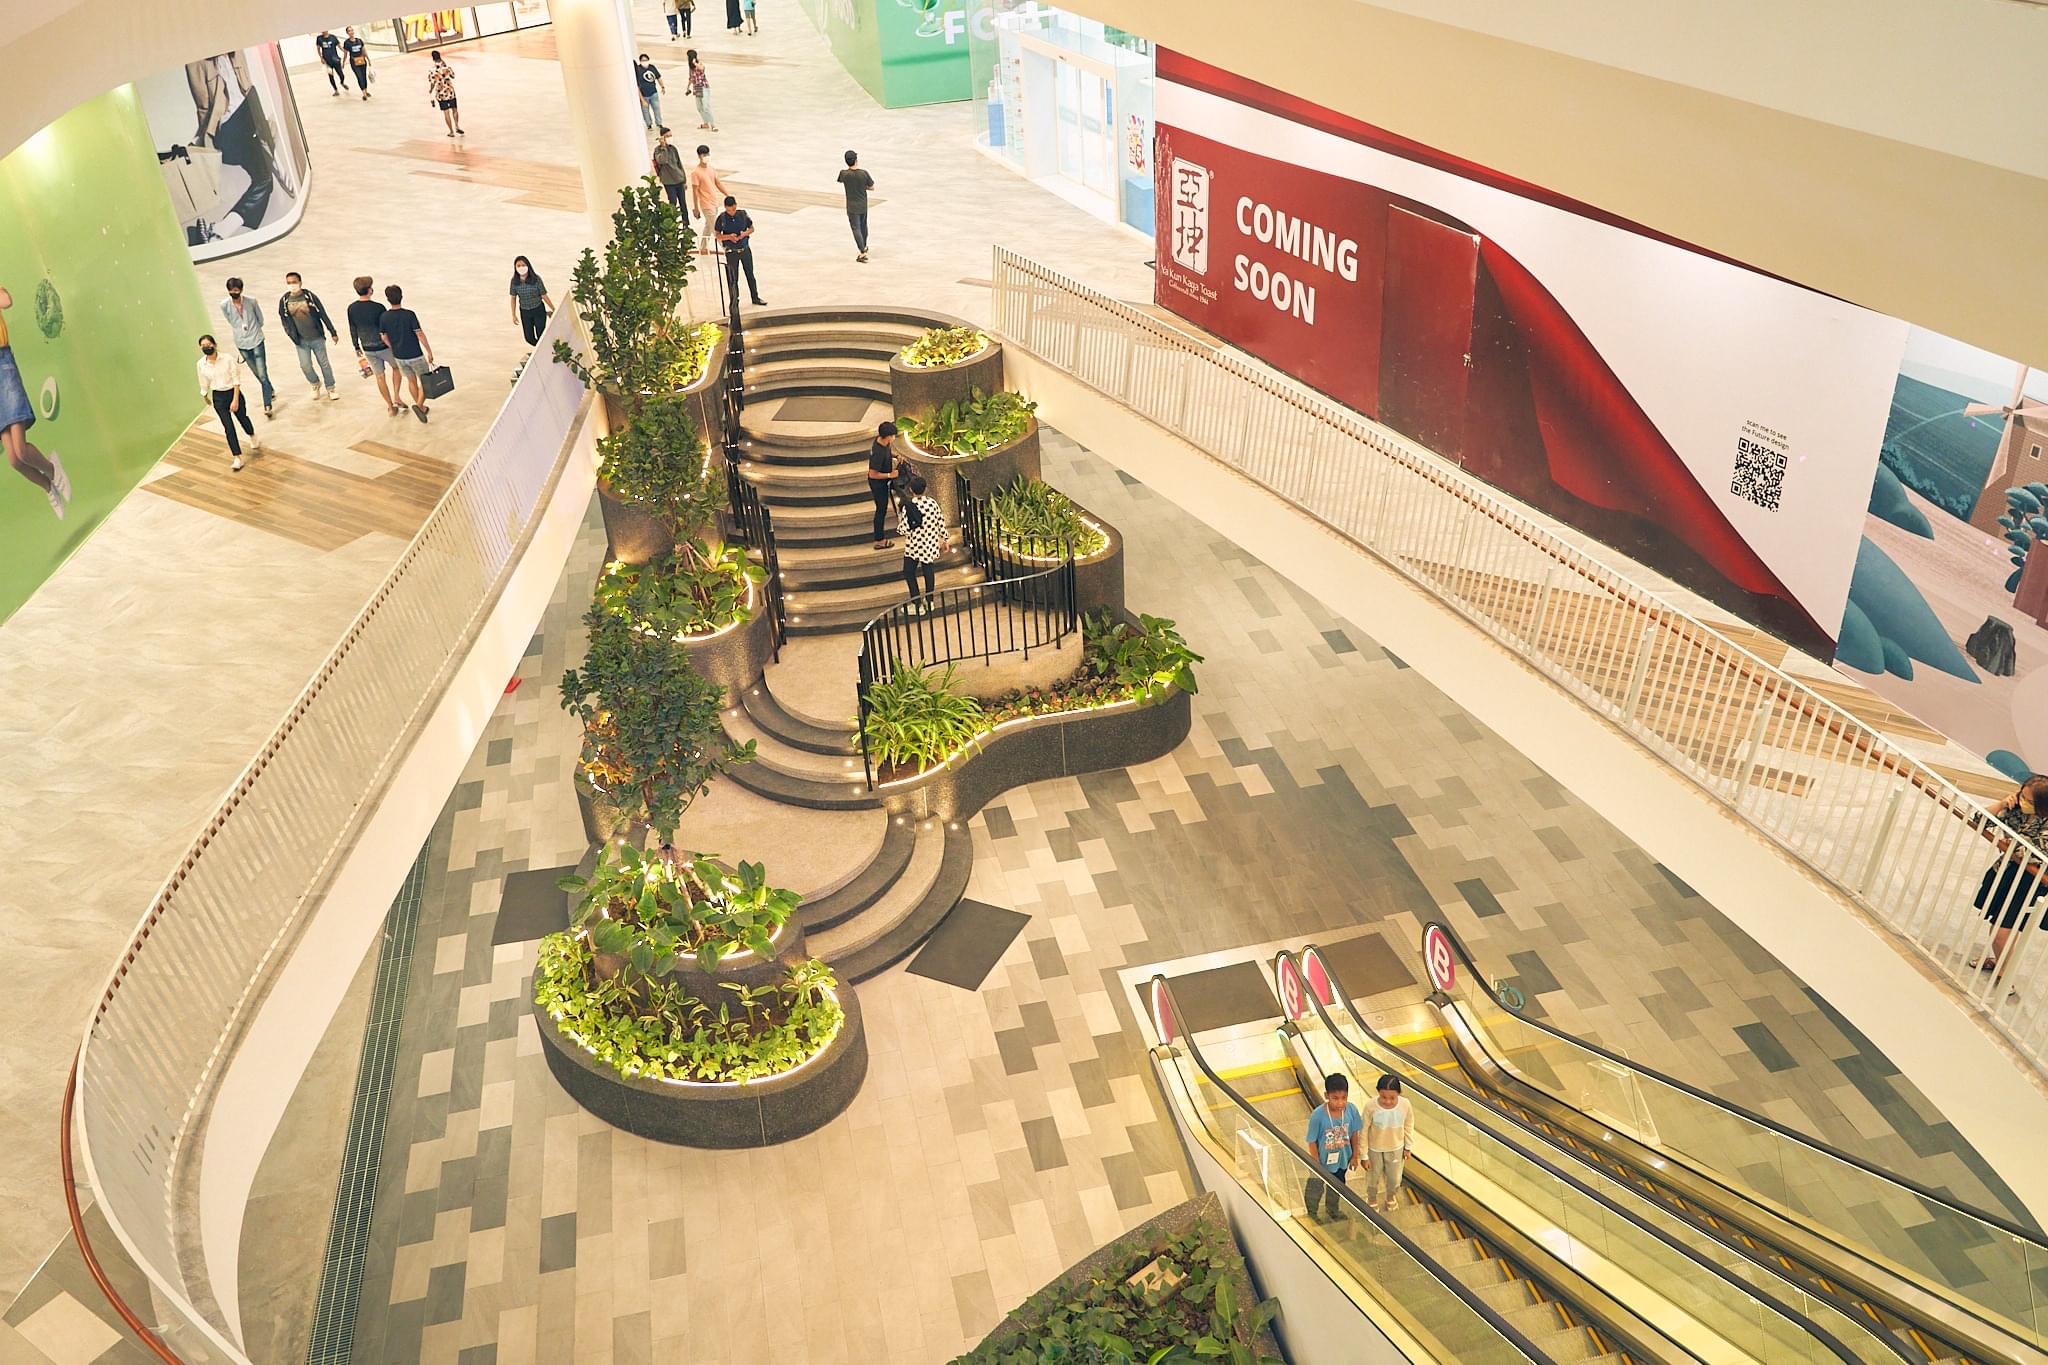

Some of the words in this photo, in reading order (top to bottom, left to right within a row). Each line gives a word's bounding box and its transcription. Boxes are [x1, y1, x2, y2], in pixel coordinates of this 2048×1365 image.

[1236, 196, 1358, 282] COMING
[1170, 268, 1182, 282] Kun
[1200, 282, 1217, 300] Toast
[1234, 254, 1316, 326] SOON
[1741, 425, 1751, 434] the
[1770, 438, 1789, 450] design
[1746, 420, 1759, 429] scan
[1760, 425, 1769, 433] me
[1777, 432, 1787, 441] see
[1433, 935, 1450, 983] B
[1285, 966, 1299, 1014] B
